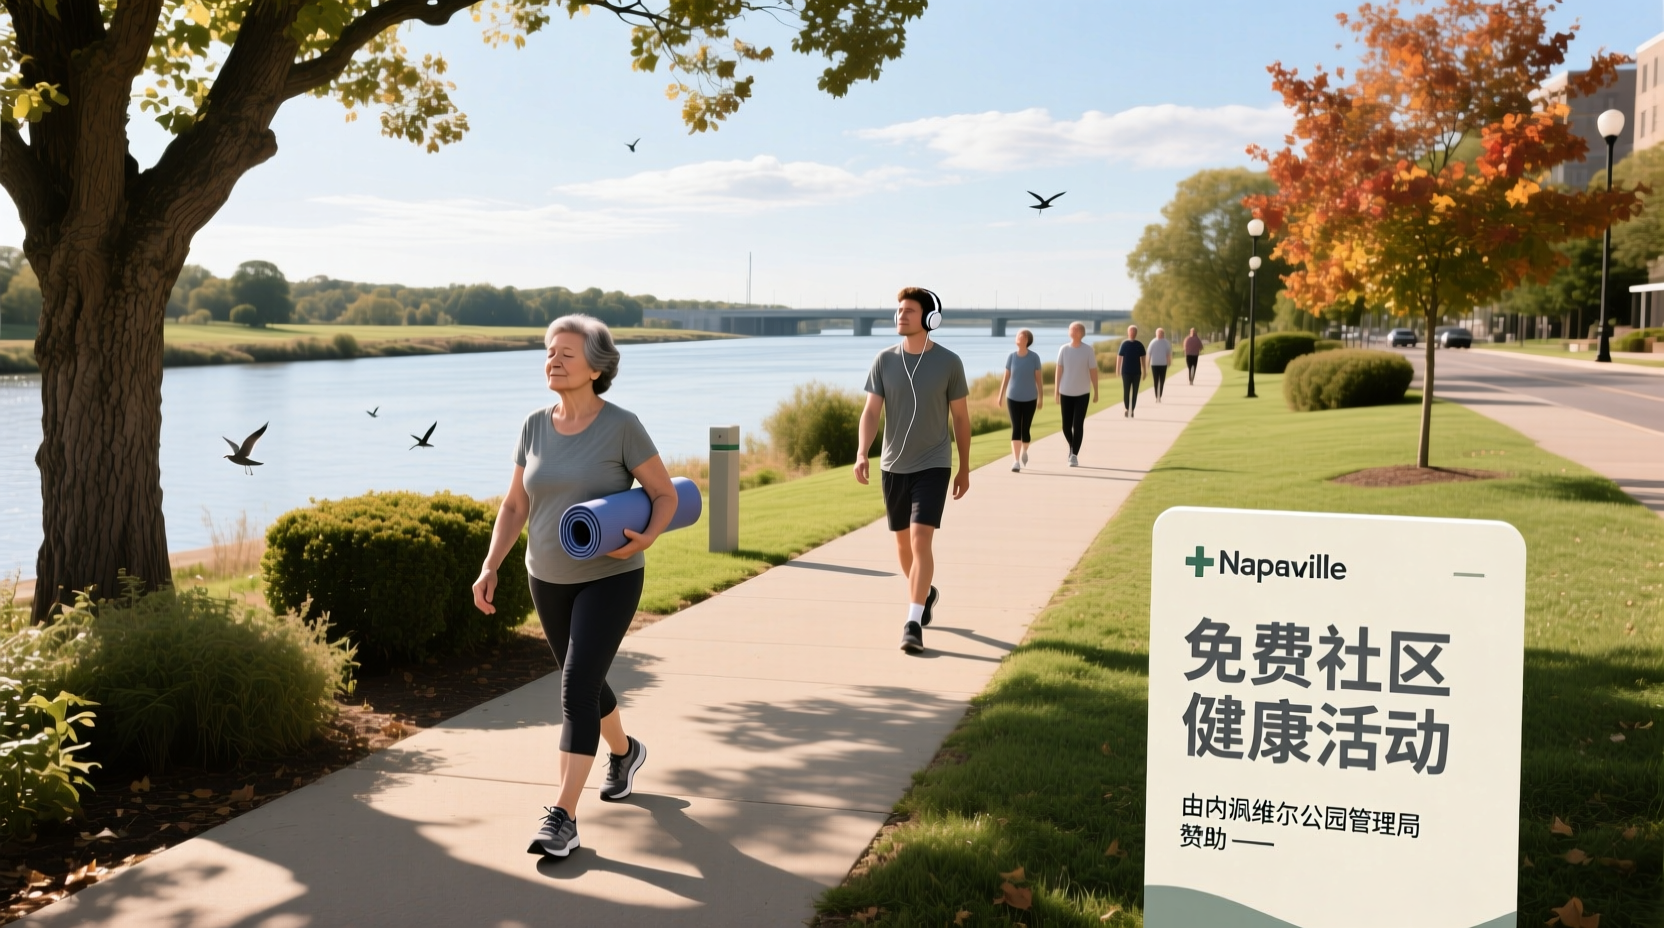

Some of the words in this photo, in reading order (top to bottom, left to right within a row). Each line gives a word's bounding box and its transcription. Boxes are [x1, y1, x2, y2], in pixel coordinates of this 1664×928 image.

[1219, 549, 1347, 584] Napaville
[1183, 616, 1451, 697] 免费社区
[1181, 691, 1450, 775] 健康活动
